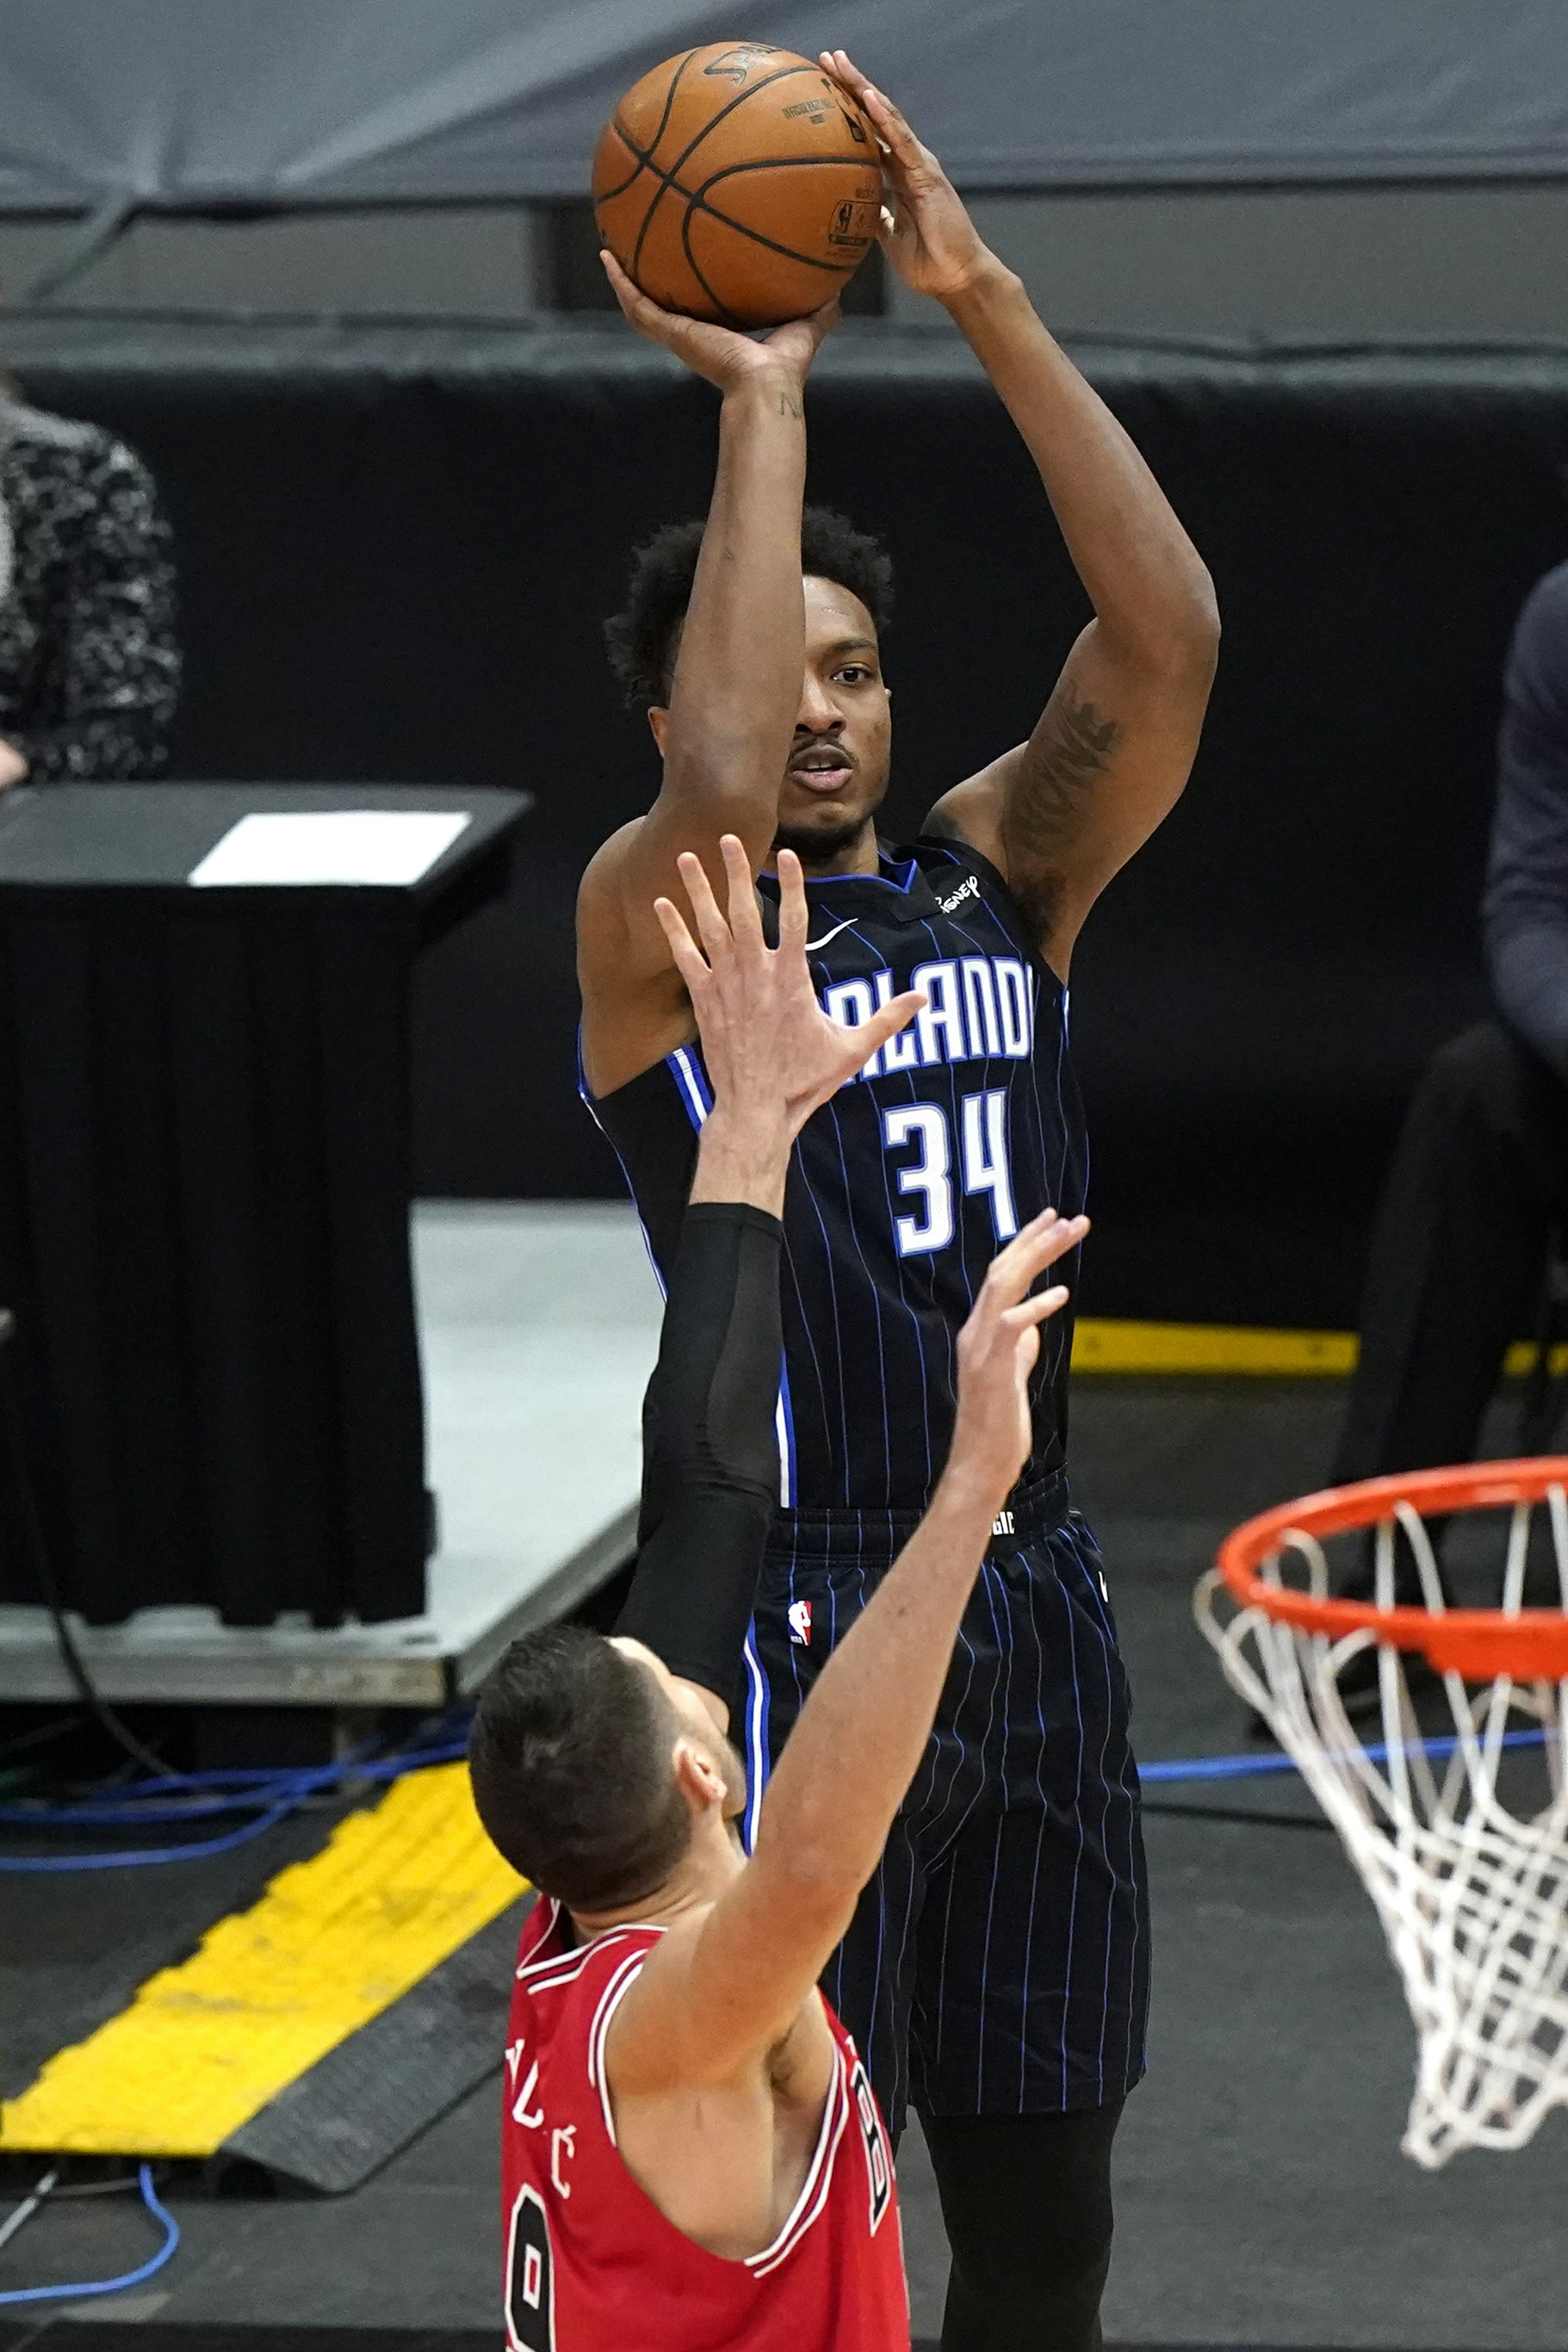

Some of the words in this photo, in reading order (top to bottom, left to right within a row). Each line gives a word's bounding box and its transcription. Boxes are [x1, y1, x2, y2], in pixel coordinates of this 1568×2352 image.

[823, 955, 1034, 1088] RLAND
[883, 1091, 1018, 1257] 34
[992, 1511, 1015, 1535] GIC
